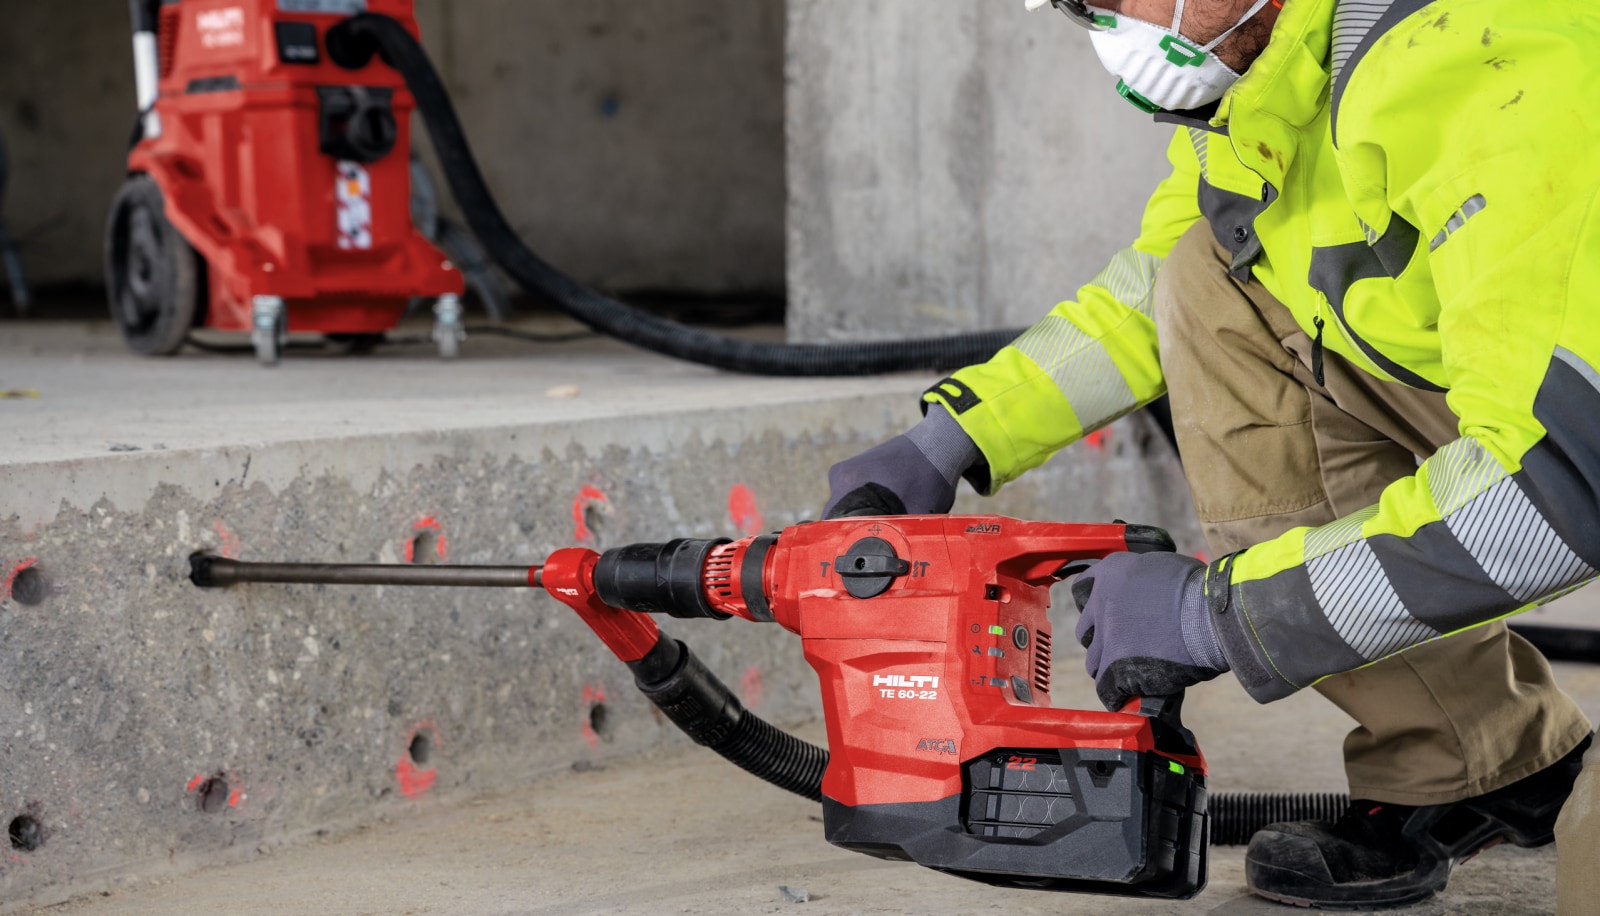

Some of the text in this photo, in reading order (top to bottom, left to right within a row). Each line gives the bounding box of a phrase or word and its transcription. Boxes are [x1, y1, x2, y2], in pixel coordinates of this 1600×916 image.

[977, 523, 1001, 534] AVR
[873, 674, 939, 689] HILTI
[879, 688, 938, 700] TE 60-22
[1006, 755, 1037, 771] 22
